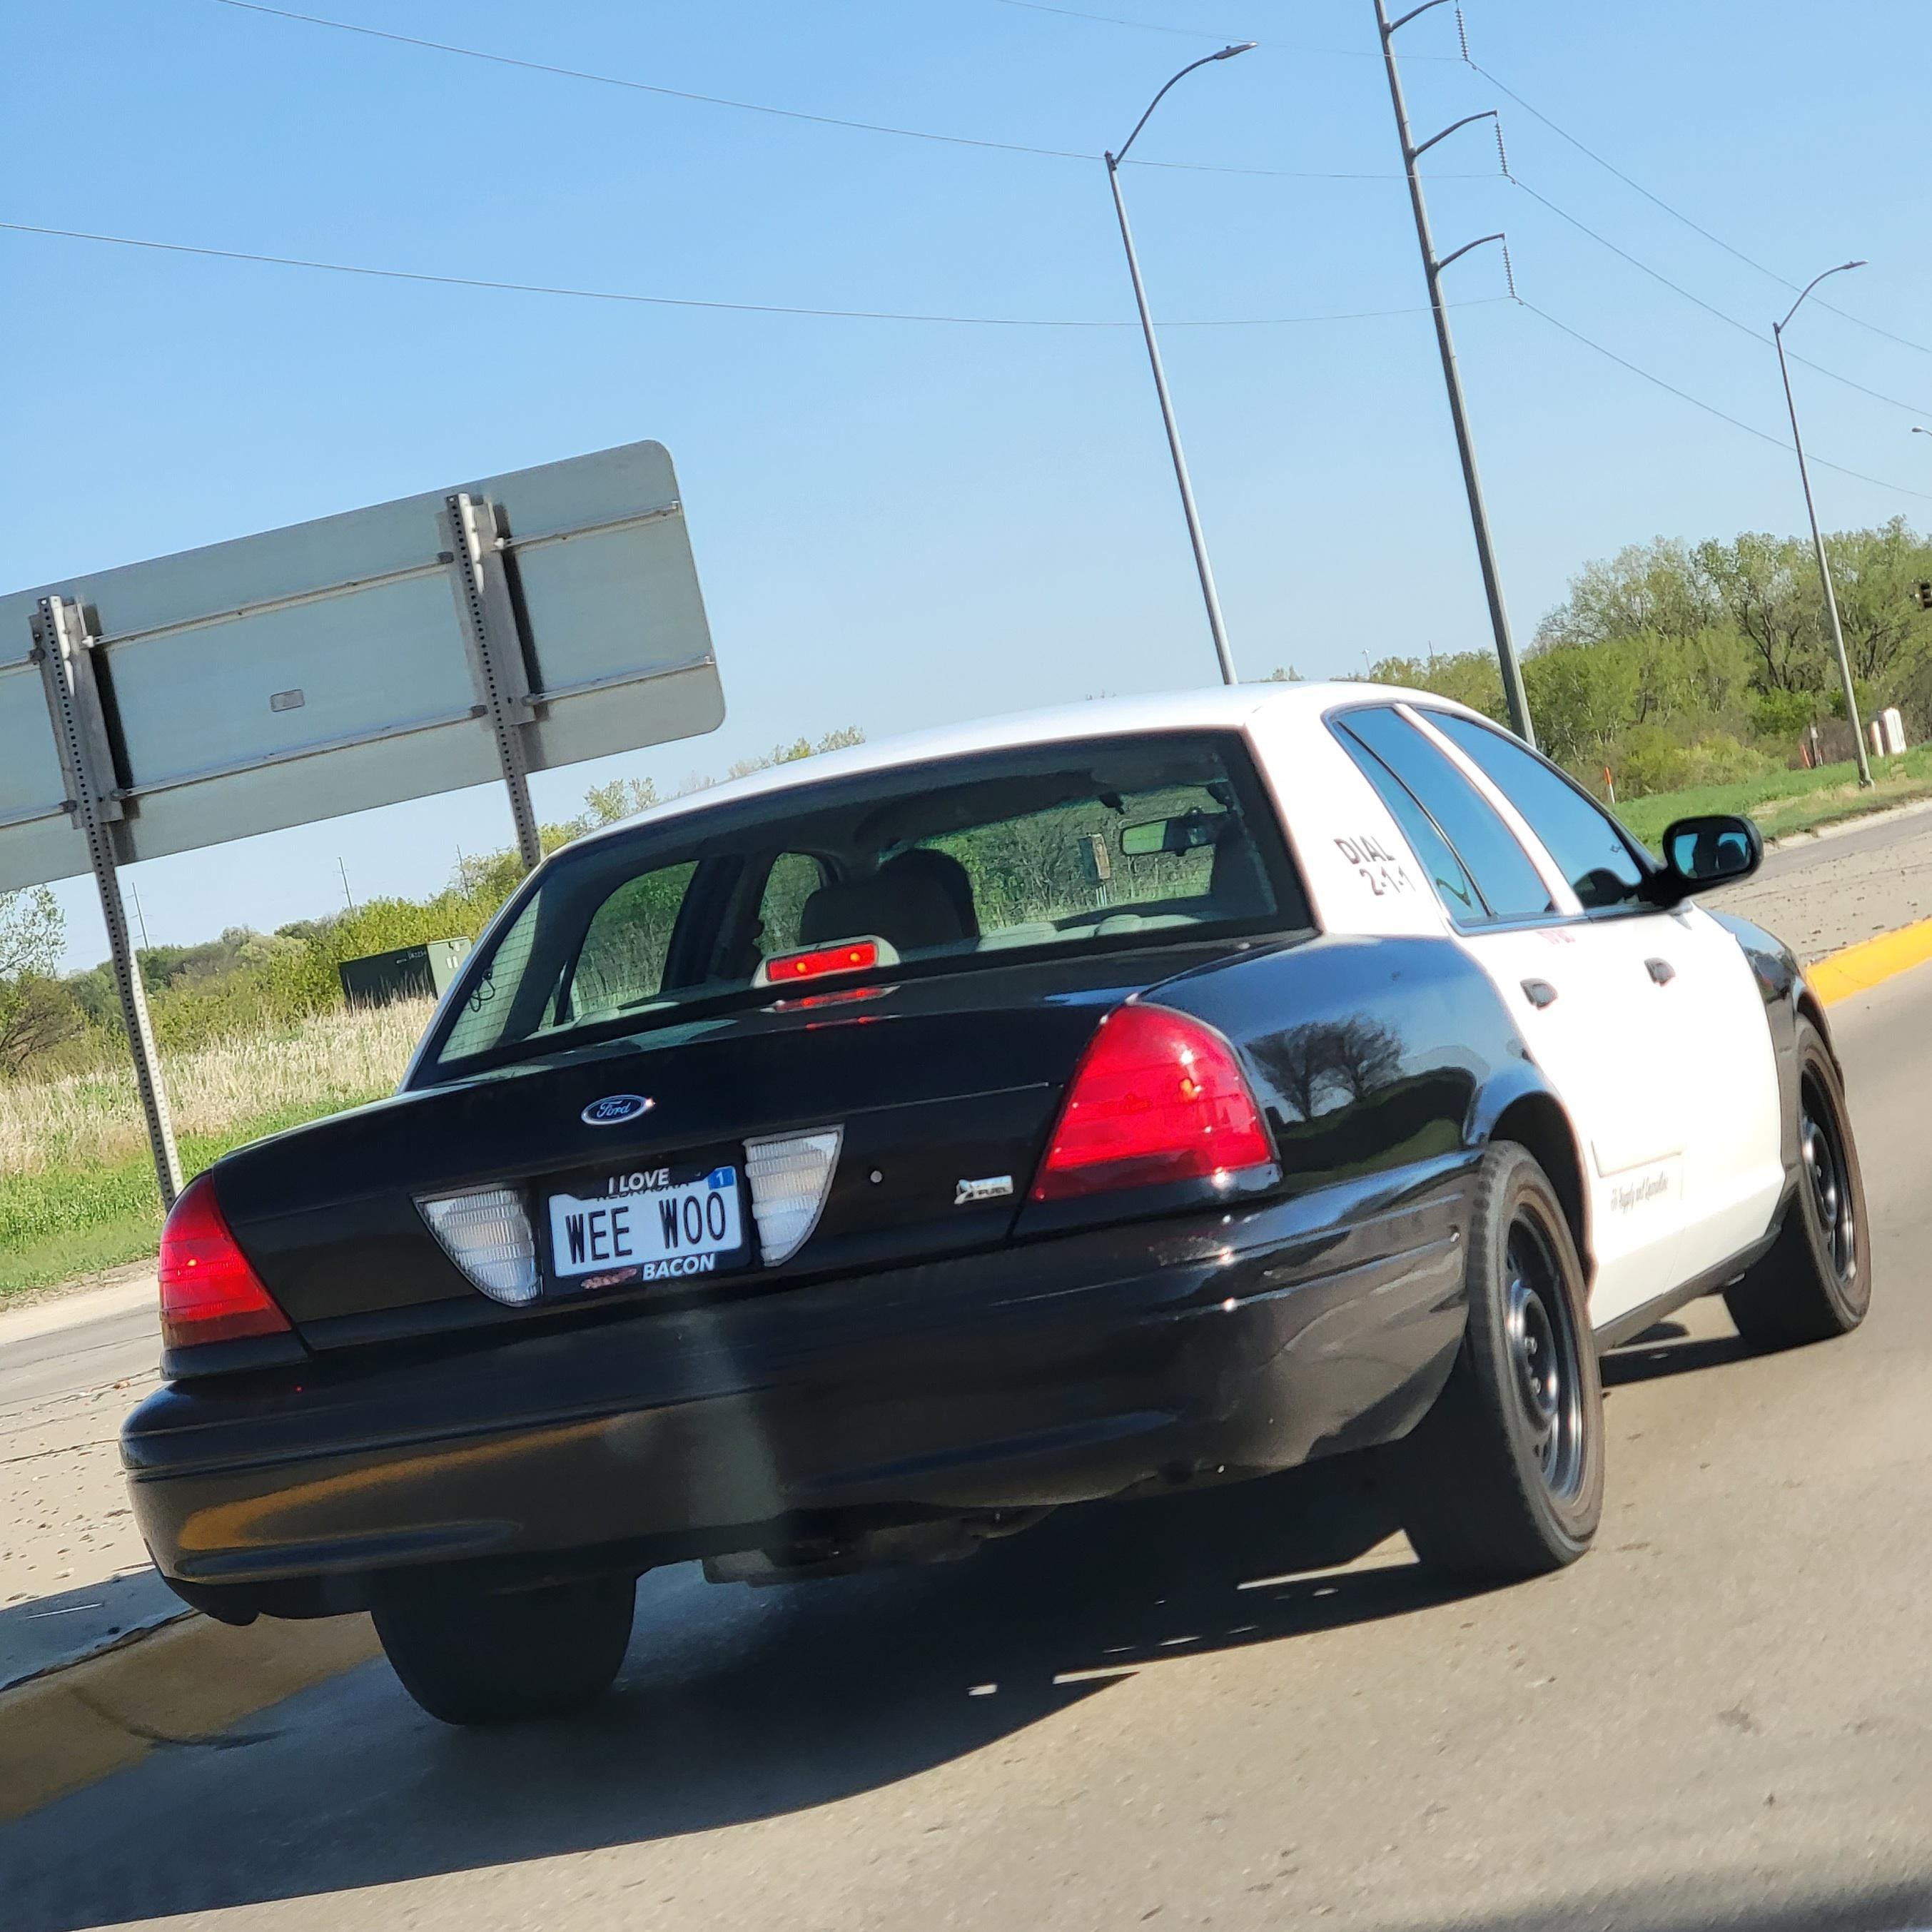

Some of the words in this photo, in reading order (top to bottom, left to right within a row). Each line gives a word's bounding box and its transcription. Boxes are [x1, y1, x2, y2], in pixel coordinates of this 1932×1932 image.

[1333, 835, 1396, 864] DIAL
[597, 1100, 632, 1118] Ford
[608, 1176, 615, 1195] I
[619, 1168, 669, 1193] LOVE
[716, 1170, 725, 1186] 1
[565, 1206, 633, 1265] WEE
[642, 1253, 714, 1281] BACON
